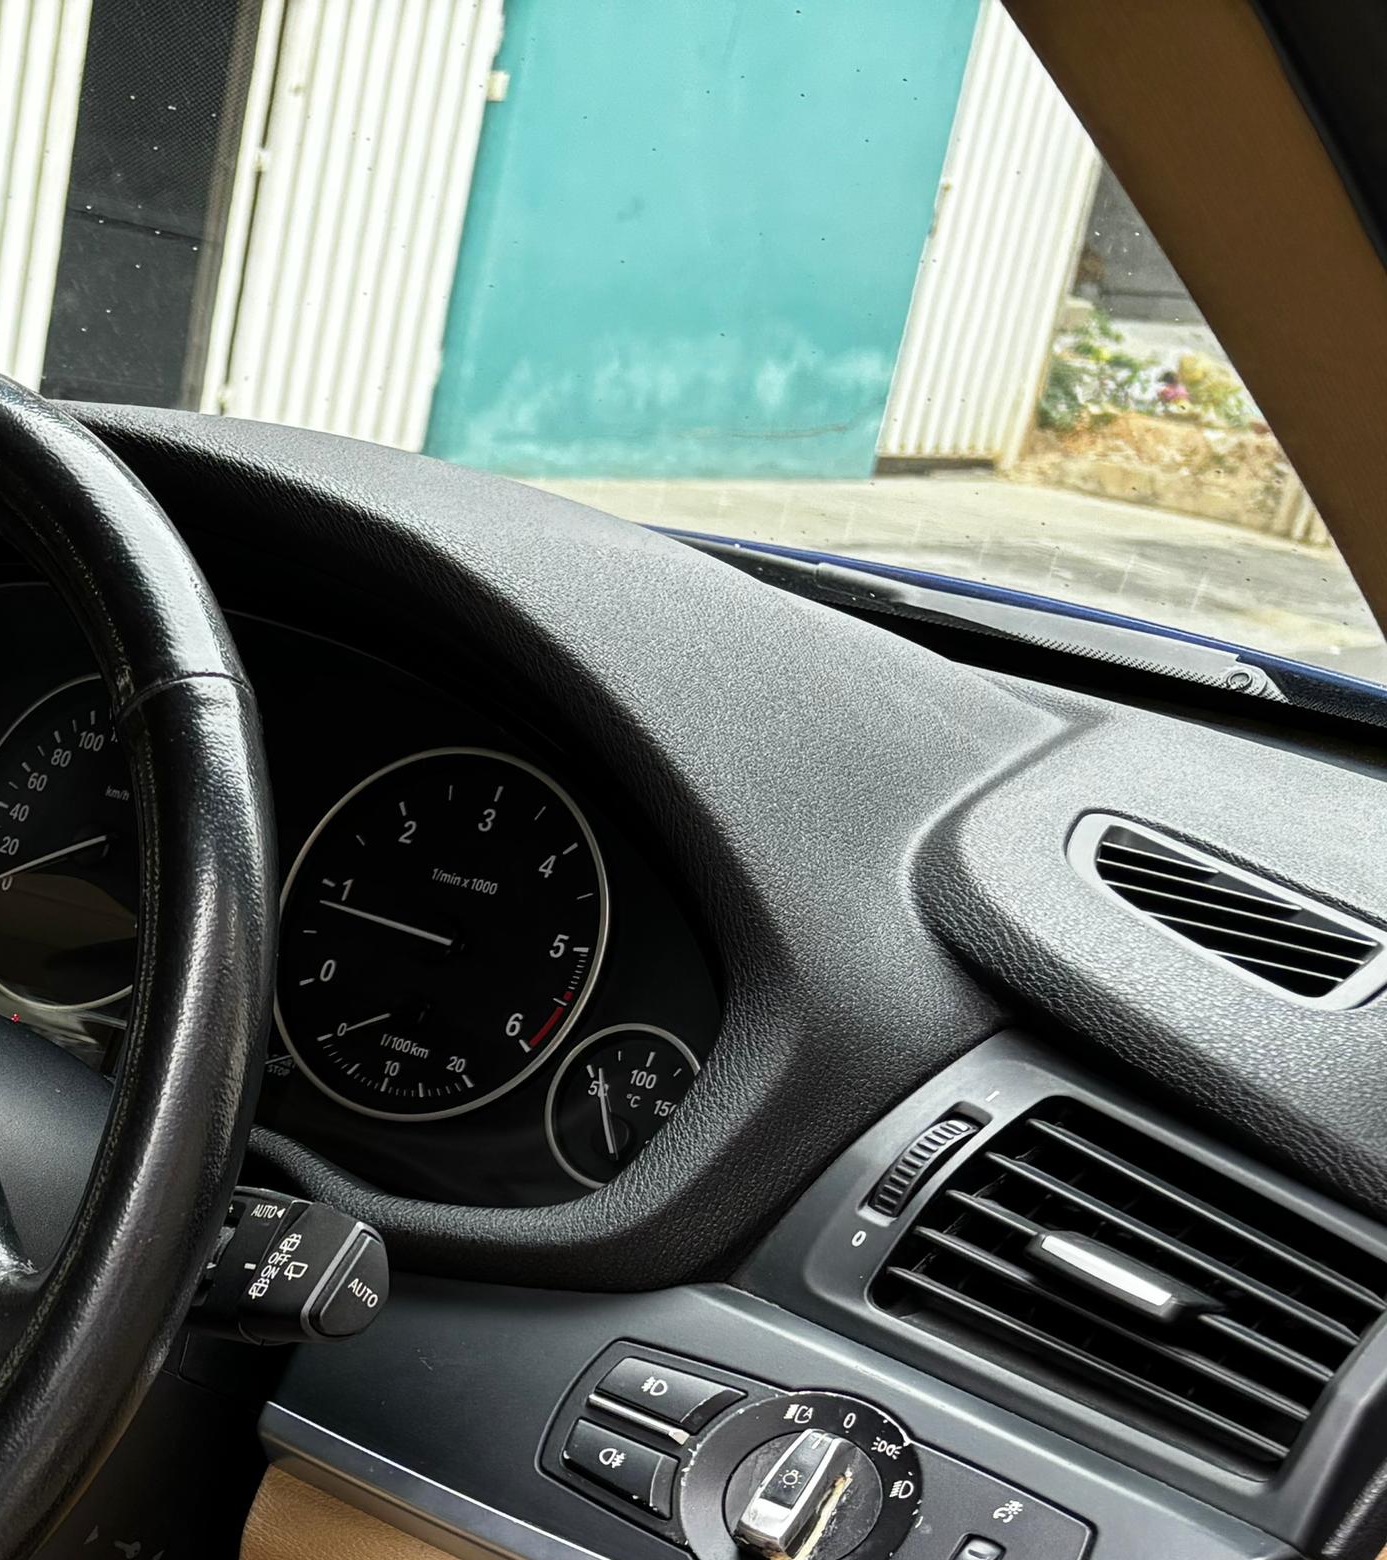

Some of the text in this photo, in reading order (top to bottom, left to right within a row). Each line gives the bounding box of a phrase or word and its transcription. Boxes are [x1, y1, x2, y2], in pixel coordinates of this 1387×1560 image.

[78, 731, 105, 752] 100
[51, 749, 72, 768] 80
[27, 773, 48, 791] 60
[105, 785, 130, 801] km/h
[9, 804, 29, 822] 40
[478, 808, 496, 832] 3
[398, 820, 417, 844] 2
[0, 836, 19, 856] 20
[538, 855, 557, 878] 4
[1, 875, 13, 891] 0
[341, 878, 354, 901] 1
[431, 868, 461, 887] 1/min
[470, 877, 498, 895] 1000
[549, 934, 569, 959] 5
[319, 959, 336, 982] 0
[336, 1022, 348, 1037] 0
[505, 1012, 524, 1037] 6
[384, 1060, 399, 1076] 10
[446, 1056, 466, 1073] 20
[630, 1069, 657, 1089] 100
[251, 1204, 277, 1218] AUTO
[267, 1252, 291, 1266] OFF
[260, 1265, 280, 1280] ON
[347, 1277, 379, 1309] AUTO
[843, 1412, 856, 1429] 0
